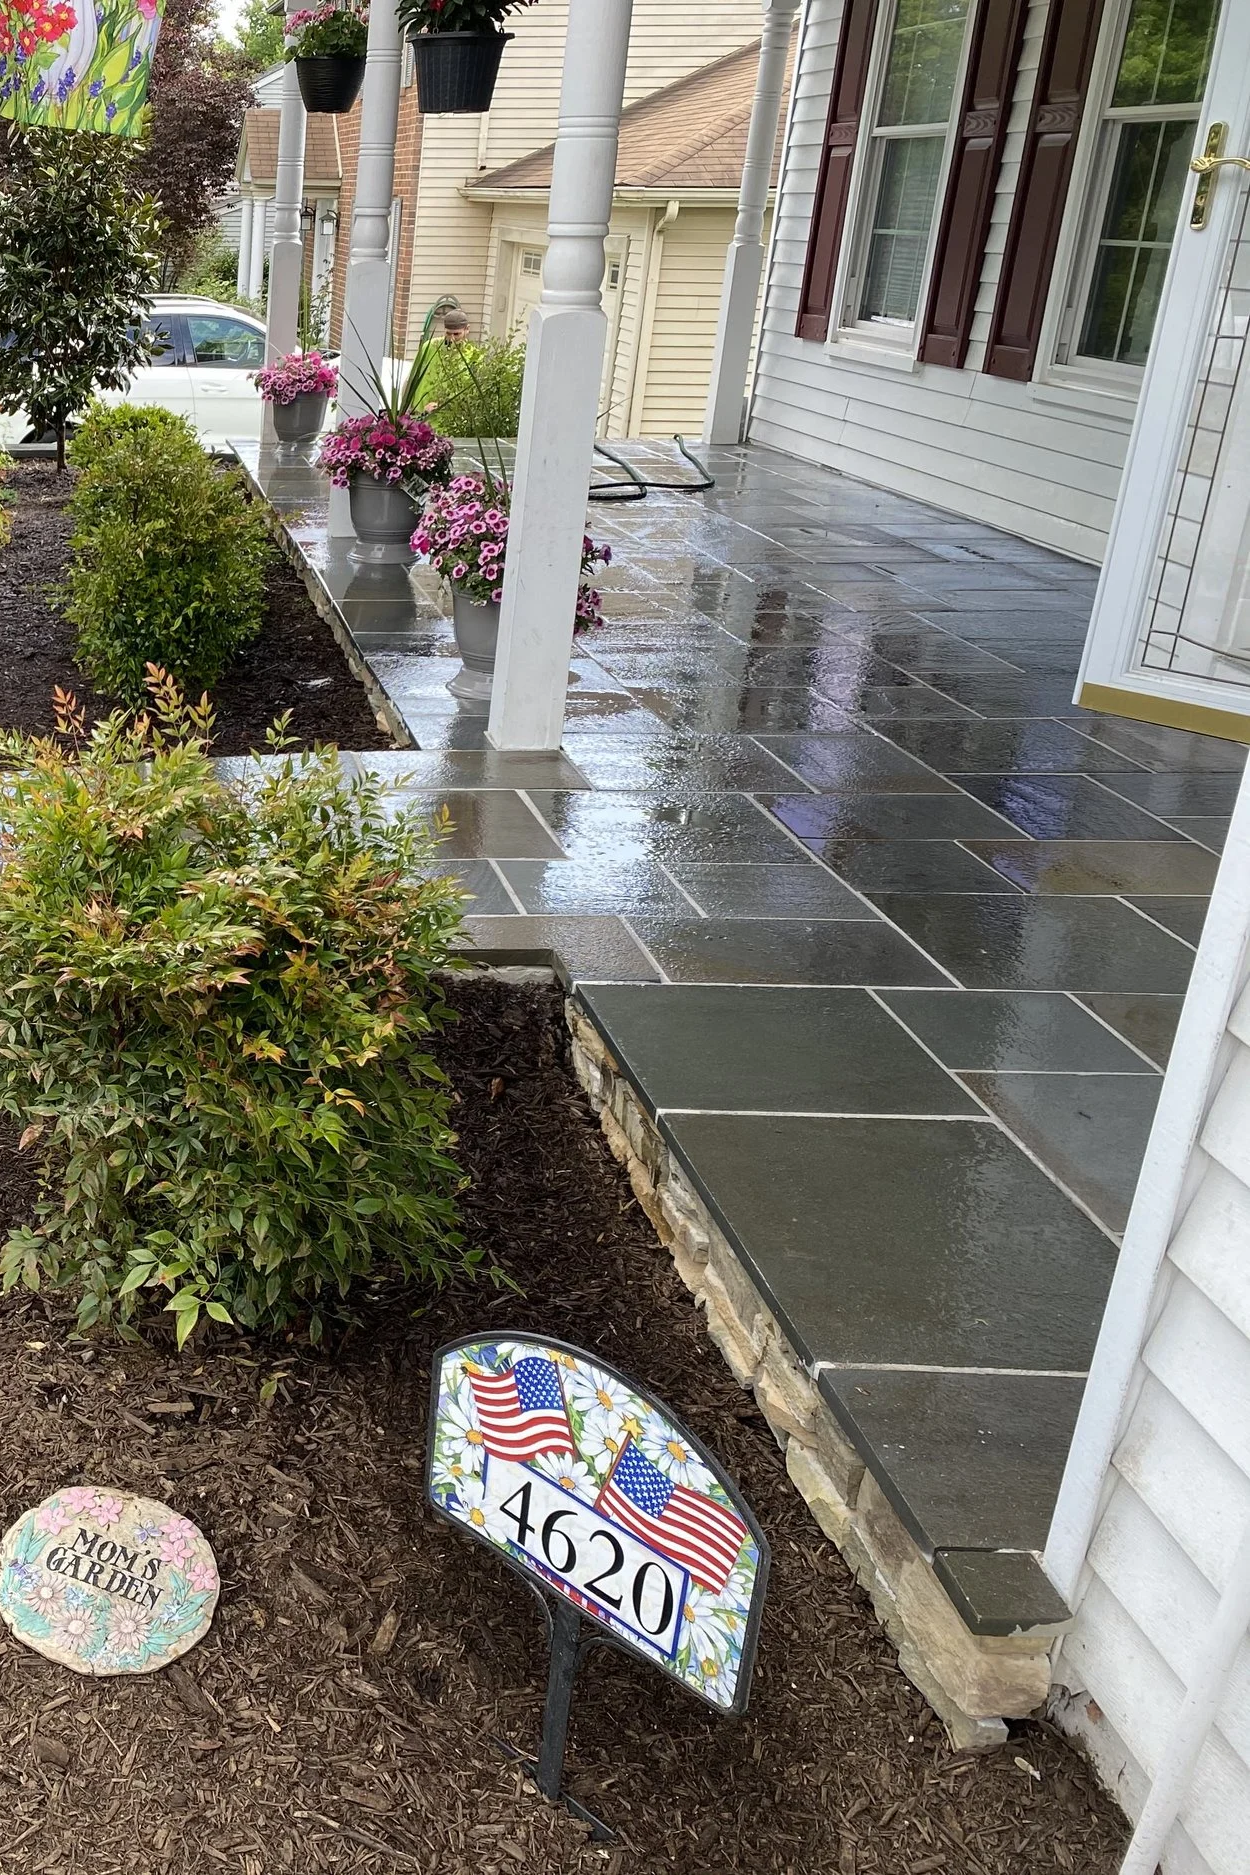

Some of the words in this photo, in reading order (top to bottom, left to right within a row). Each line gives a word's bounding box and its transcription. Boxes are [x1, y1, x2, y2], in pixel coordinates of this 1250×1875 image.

[46, 1546, 165, 1611] GARDEN
[69, 1527, 162, 1581] MOM'S
[498, 1481, 674, 1636] 4620
